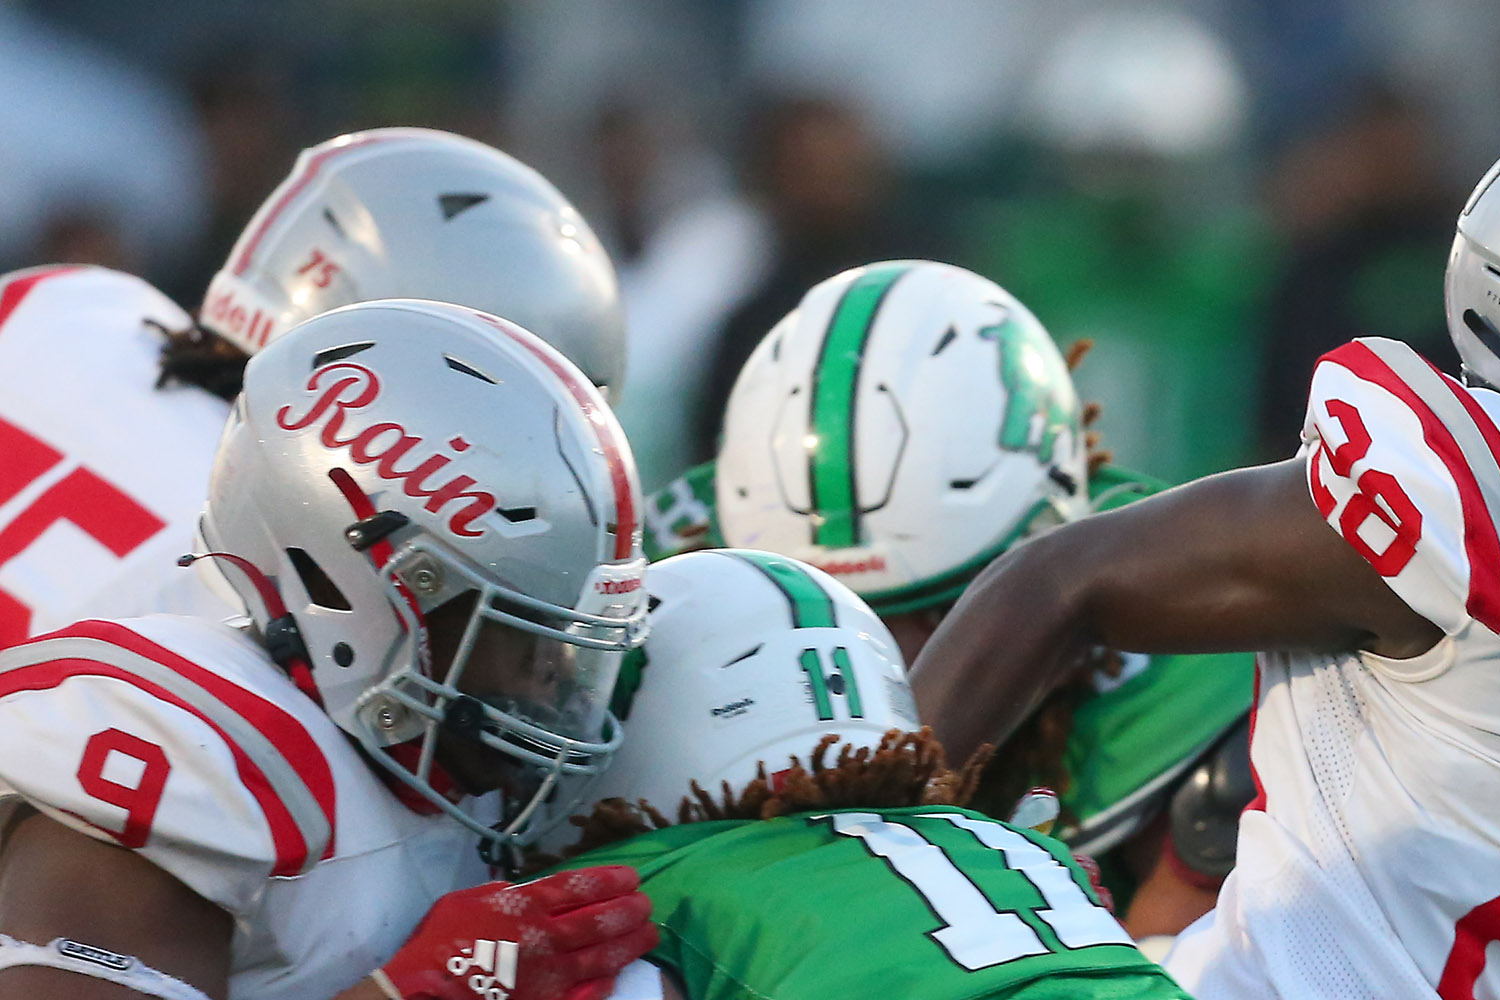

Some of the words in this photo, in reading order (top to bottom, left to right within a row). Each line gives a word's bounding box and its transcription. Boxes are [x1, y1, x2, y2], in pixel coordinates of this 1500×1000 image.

[297, 246, 342, 288] 75
[277, 362, 497, 538] Rain
[1310, 398, 1423, 578] 28
[798, 647, 864, 721] 11
[76, 727, 172, 849] 9
[804, 812, 1138, 973] 11
